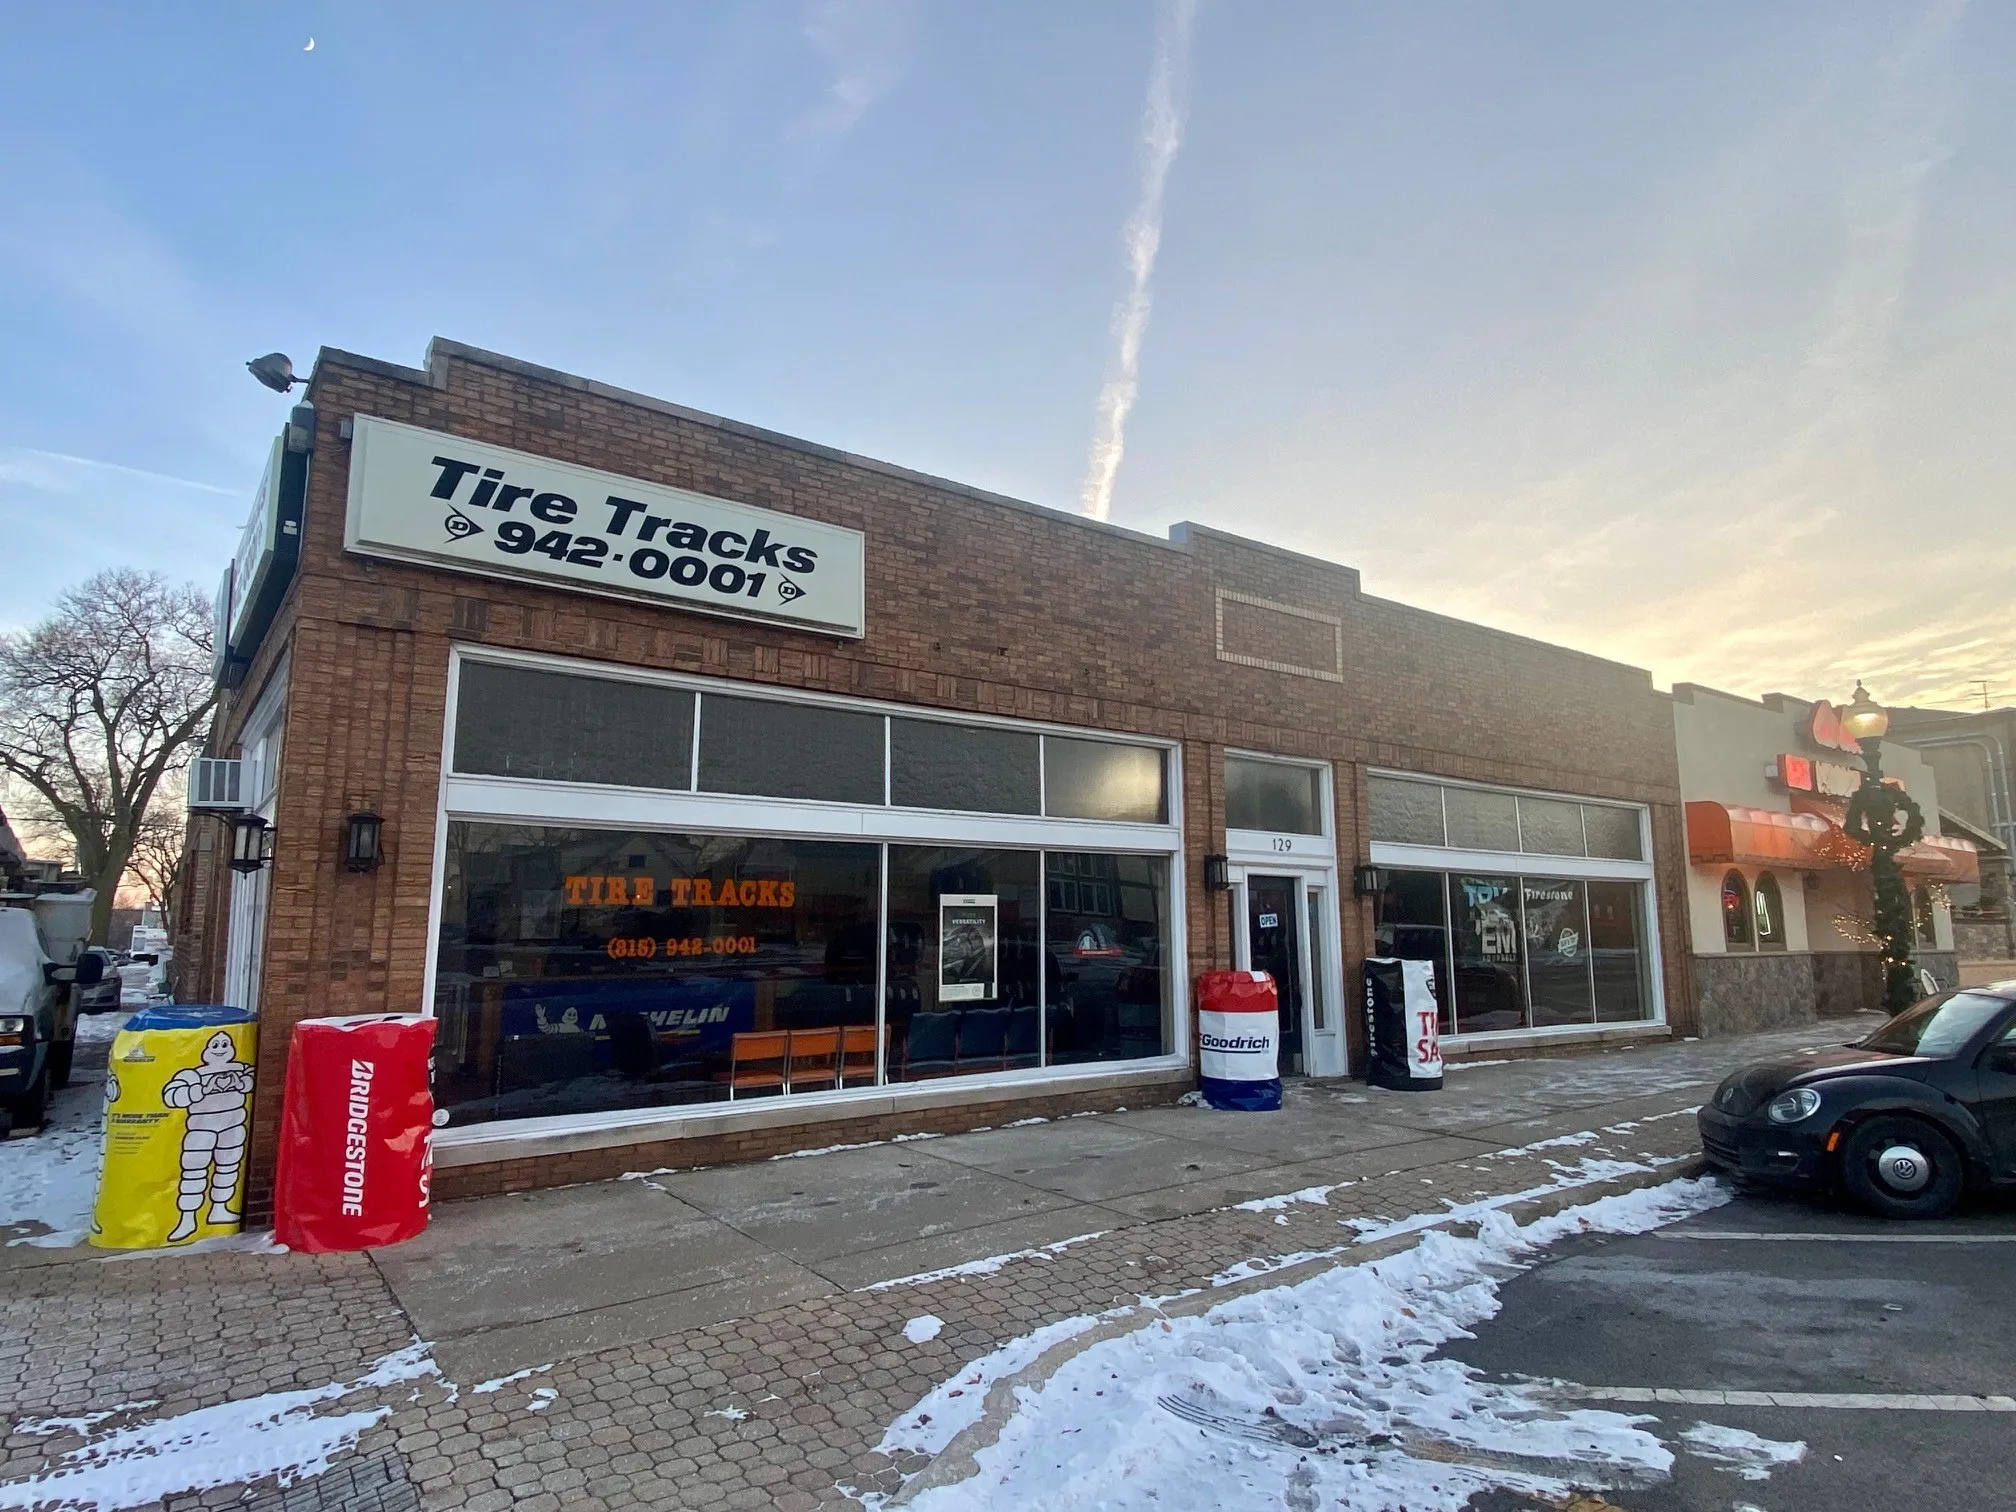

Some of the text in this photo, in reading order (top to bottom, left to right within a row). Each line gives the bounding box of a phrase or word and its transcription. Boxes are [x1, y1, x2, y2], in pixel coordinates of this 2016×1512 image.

[430, 456, 818, 574] Tire Tracks
[1272, 838, 1292, 852] 129
[565, 876, 796, 908] TIRE TRACKS
[1524, 888, 1574, 901] Firestone
[1260, 915, 1277, 926] OPEN
[607, 936, 757, 958] (815) 942-0001
[1200, 1033, 1269, 1049] Goodrich
[342, 1058, 375, 1217] BRIDGESTONE
